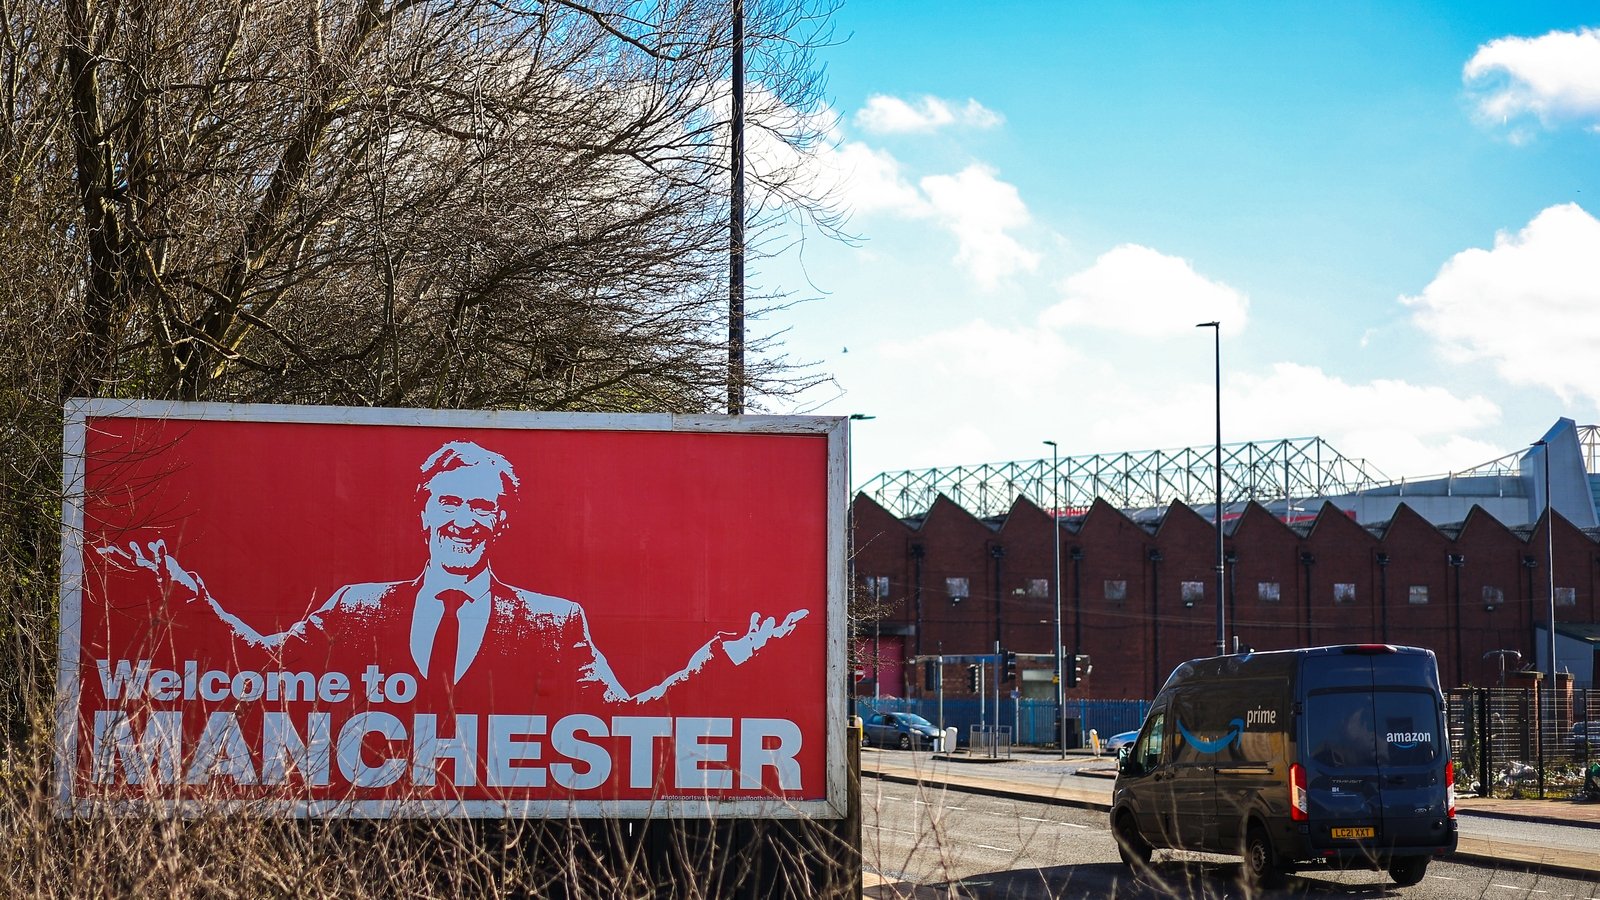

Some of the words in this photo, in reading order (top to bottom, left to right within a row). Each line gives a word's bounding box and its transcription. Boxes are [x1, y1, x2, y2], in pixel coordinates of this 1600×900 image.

[96, 659, 350, 703] Welcome
[361, 664, 417, 703] to
[1246, 705, 1277, 728] prime
[1386, 731, 1431, 743] amazon
[92, 710, 803, 791] MANCHESTER
[1335, 828, 1354, 838] LC21
[1355, 828, 1370, 837] XXT
